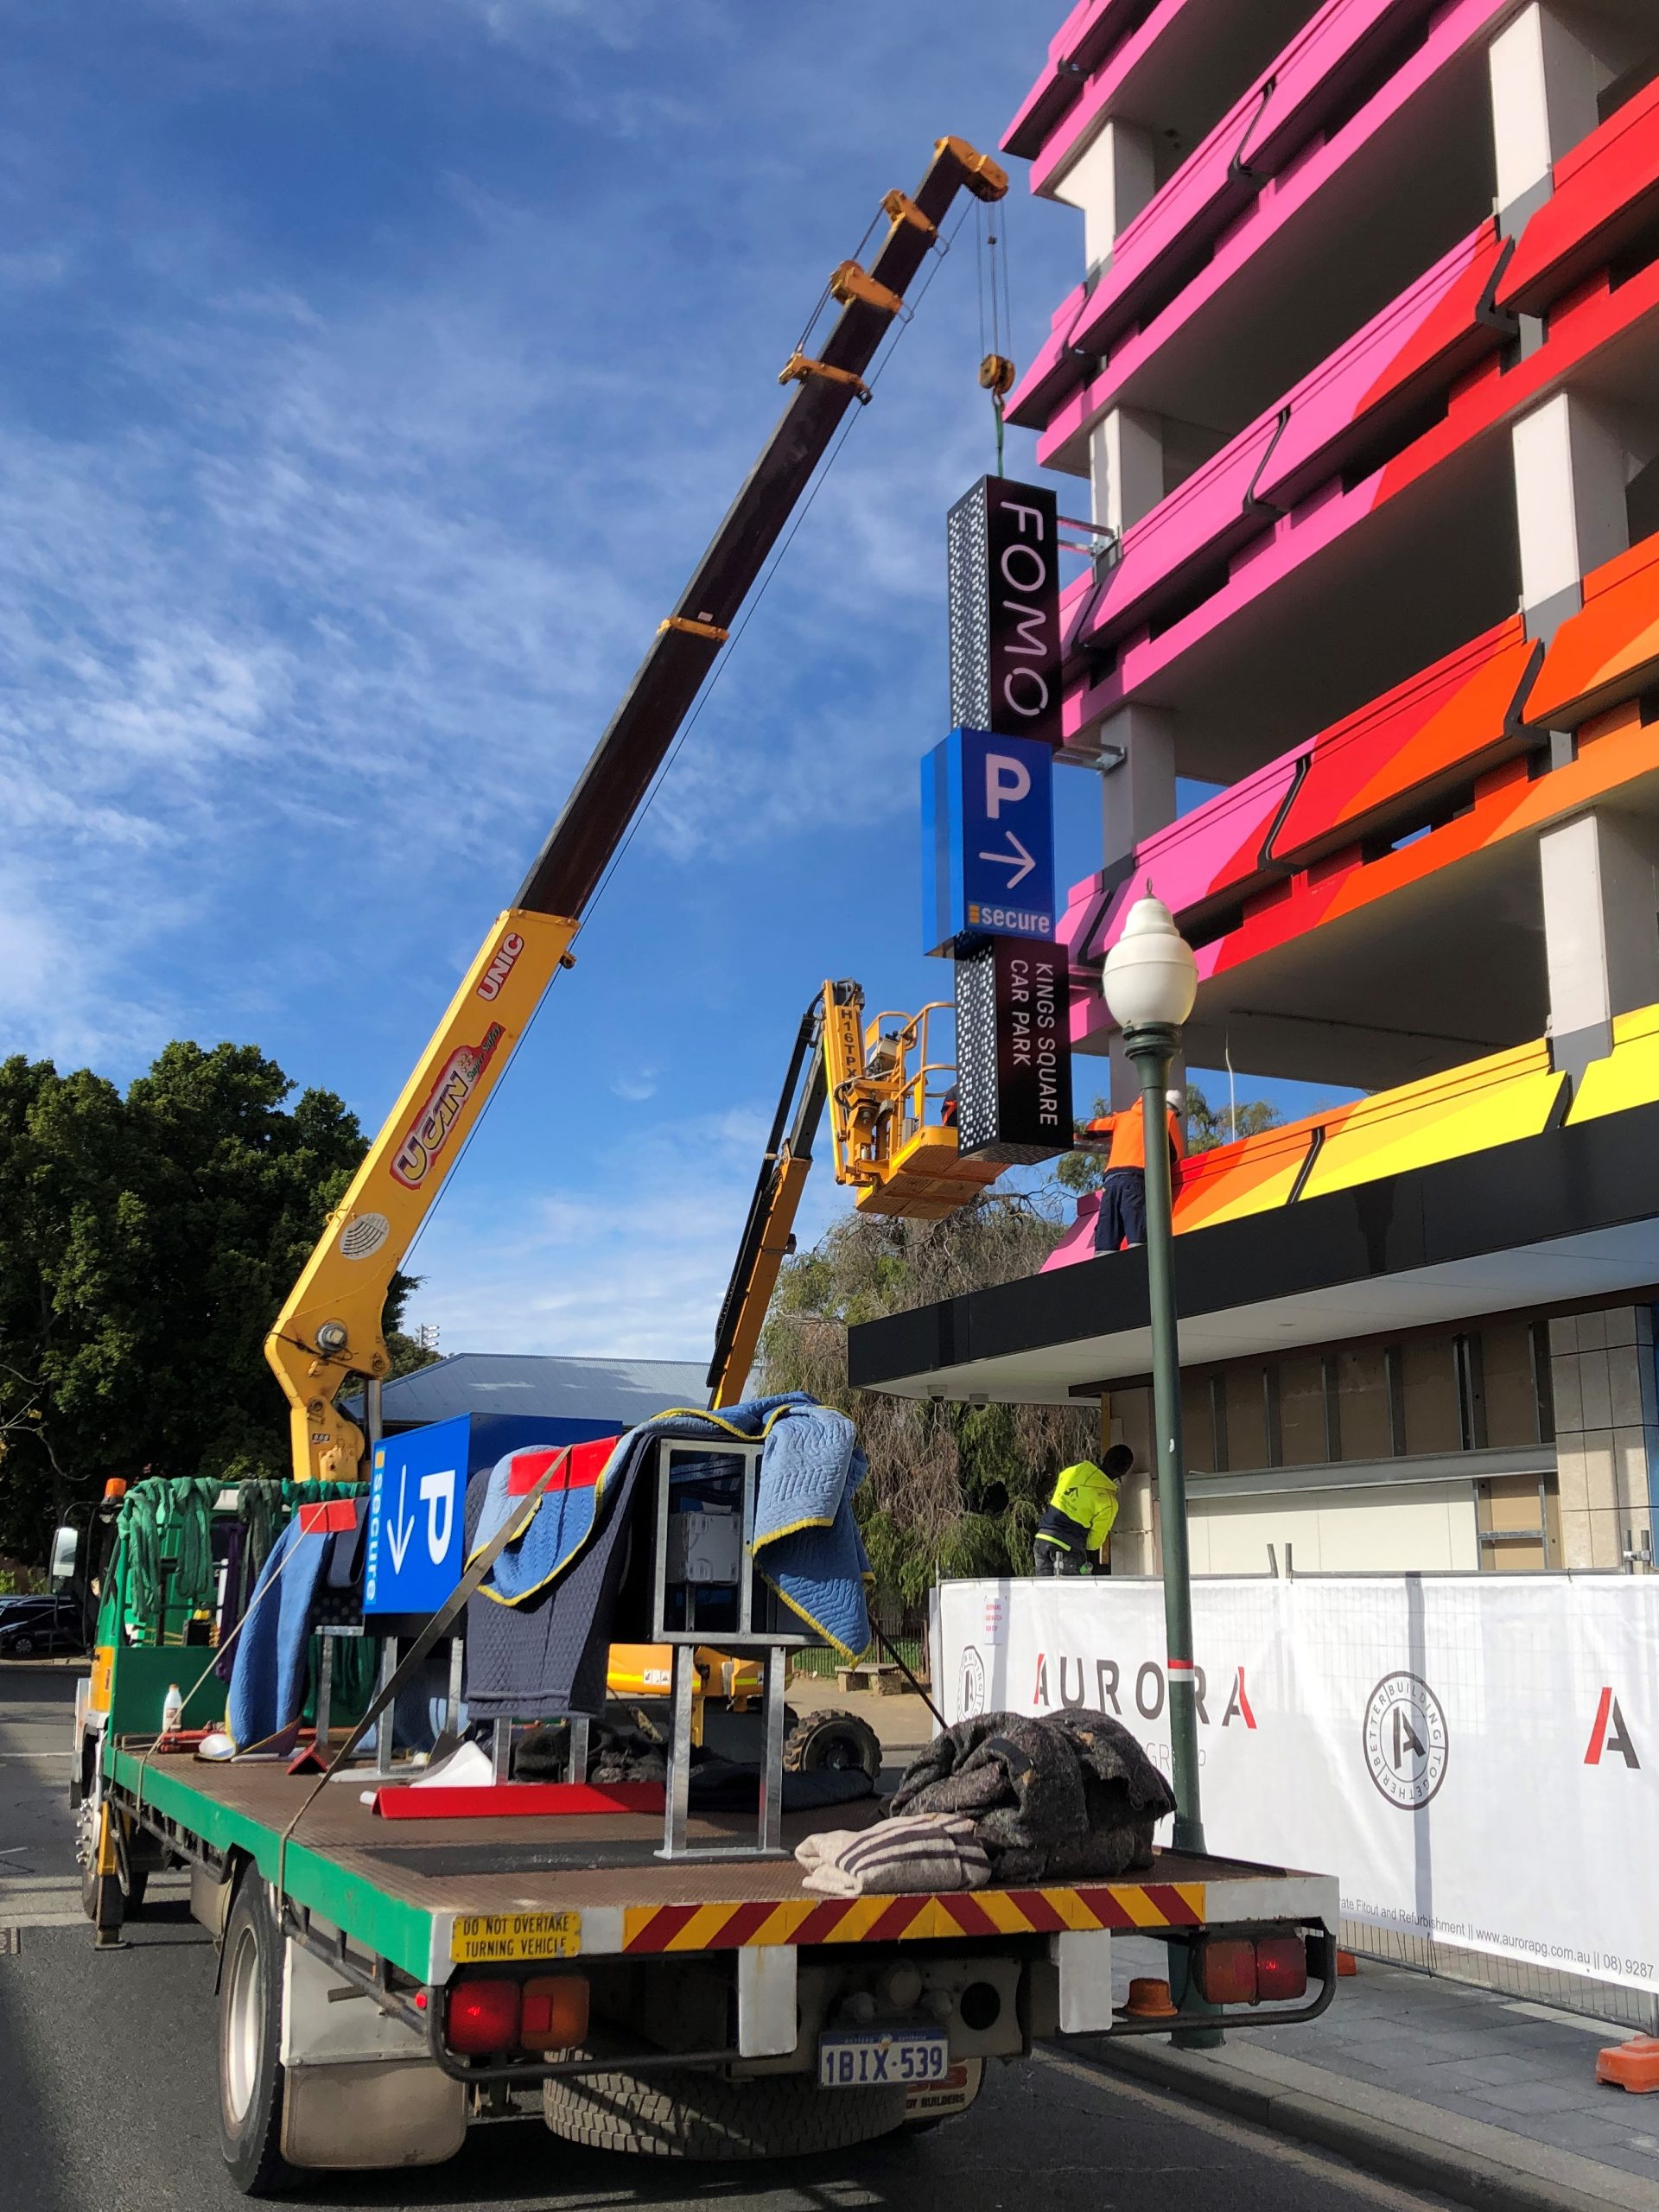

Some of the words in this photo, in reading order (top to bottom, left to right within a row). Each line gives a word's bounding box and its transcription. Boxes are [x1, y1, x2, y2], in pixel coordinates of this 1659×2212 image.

[1000, 501, 1048, 716] FOMO
[985, 753, 1032, 819] P
[982, 906, 1051, 933] secure
[478, 932, 524, 1001] UNIC
[1010, 959, 1028, 1001] CAR
[1035, 963, 1056, 1029] KINGS
[841, 1008, 858, 1078] H16TPX
[1012, 1012, 1031, 1066] PARK
[1039, 1036, 1058, 1125] SQUARE
[397, 1071, 469, 1180] UCAN
[365, 1472, 383, 1601] secure
[419, 1469, 455, 1565] P
[1033, 1653, 1257, 1730] AURORA
[1388, 1681, 1442, 1740] BUILDING
[1369, 1694, 1387, 1767] BETTER
[1382, 1755, 1441, 1800] TOGETHER
[463, 1919, 480, 1936] DO
[486, 1917, 508, 1935] NOT
[514, 1915, 569, 1935] OVERTAKE
[466, 1938, 515, 1958] TURNING
[1356, 1898, 1380, 1916] Fitout
[1382, 1907, 1397, 1920] and
[1399, 1909, 1465, 1936] Refurbishment
[1476, 1928, 1591, 1965] www.aurorapg.com.au
[1625, 1959, 1654, 1980] 9287
[921, 2093, 965, 2109] BUILDERS
